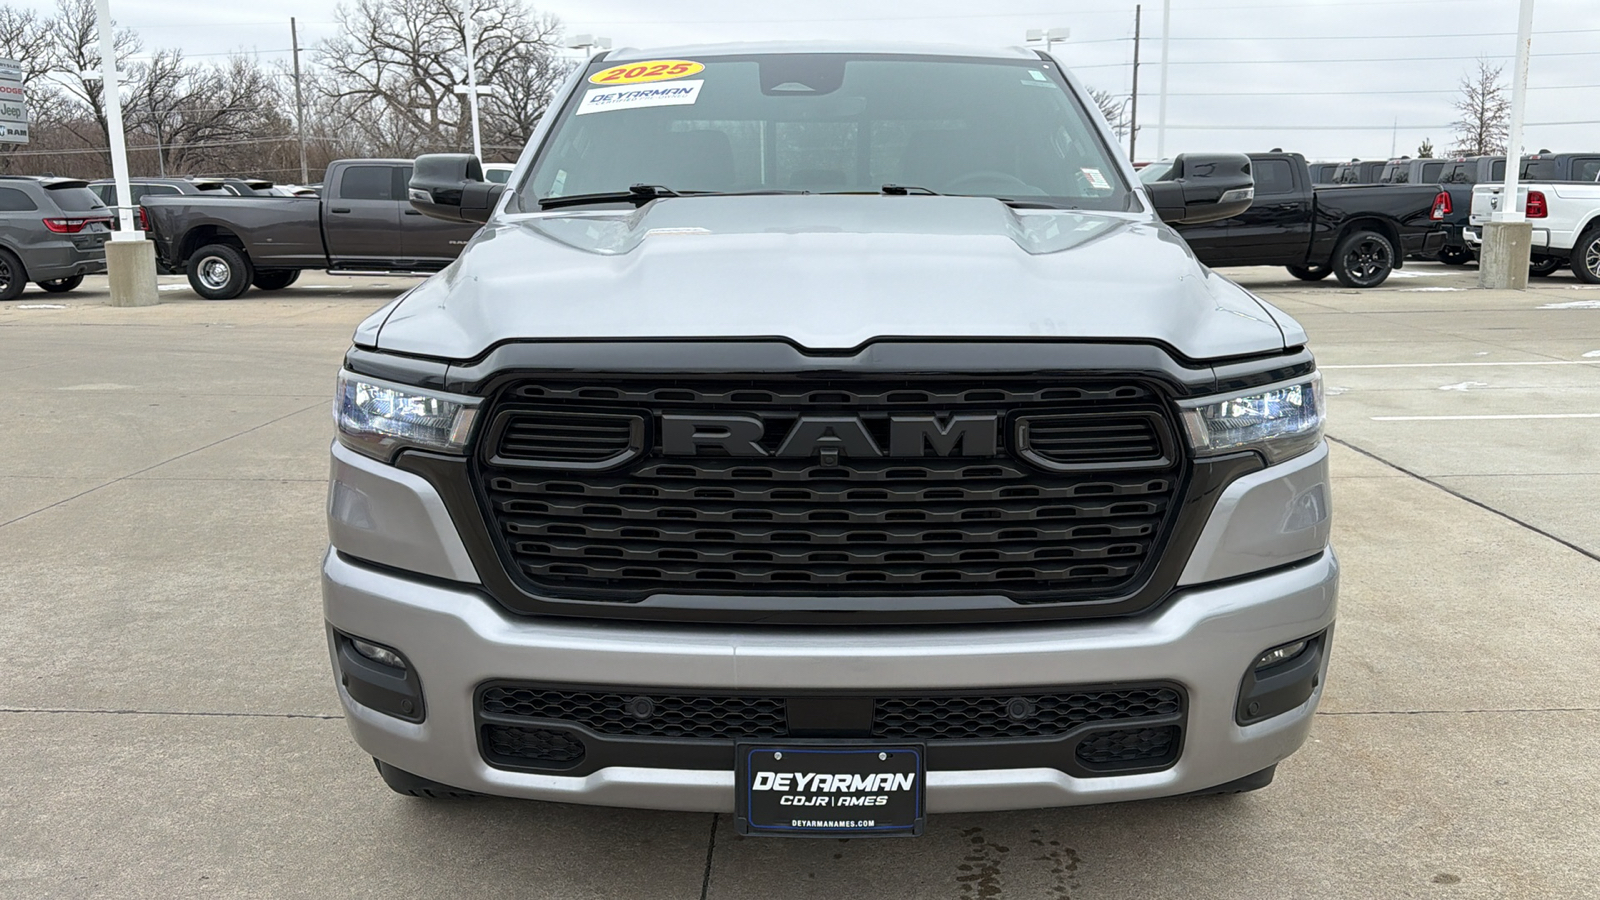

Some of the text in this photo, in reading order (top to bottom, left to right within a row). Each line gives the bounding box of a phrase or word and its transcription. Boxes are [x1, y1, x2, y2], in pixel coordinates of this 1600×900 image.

[600, 63, 693, 82] 2025
[590, 87, 694, 103] DEYARMAN
[0, 103, 21, 118] Jeep
[7, 128, 27, 136] RAM
[661, 413, 998, 457] RAM
[752, 771, 915, 792] DEYARMAN
[791, 819, 875, 828] DEYARMANAMES.COM
